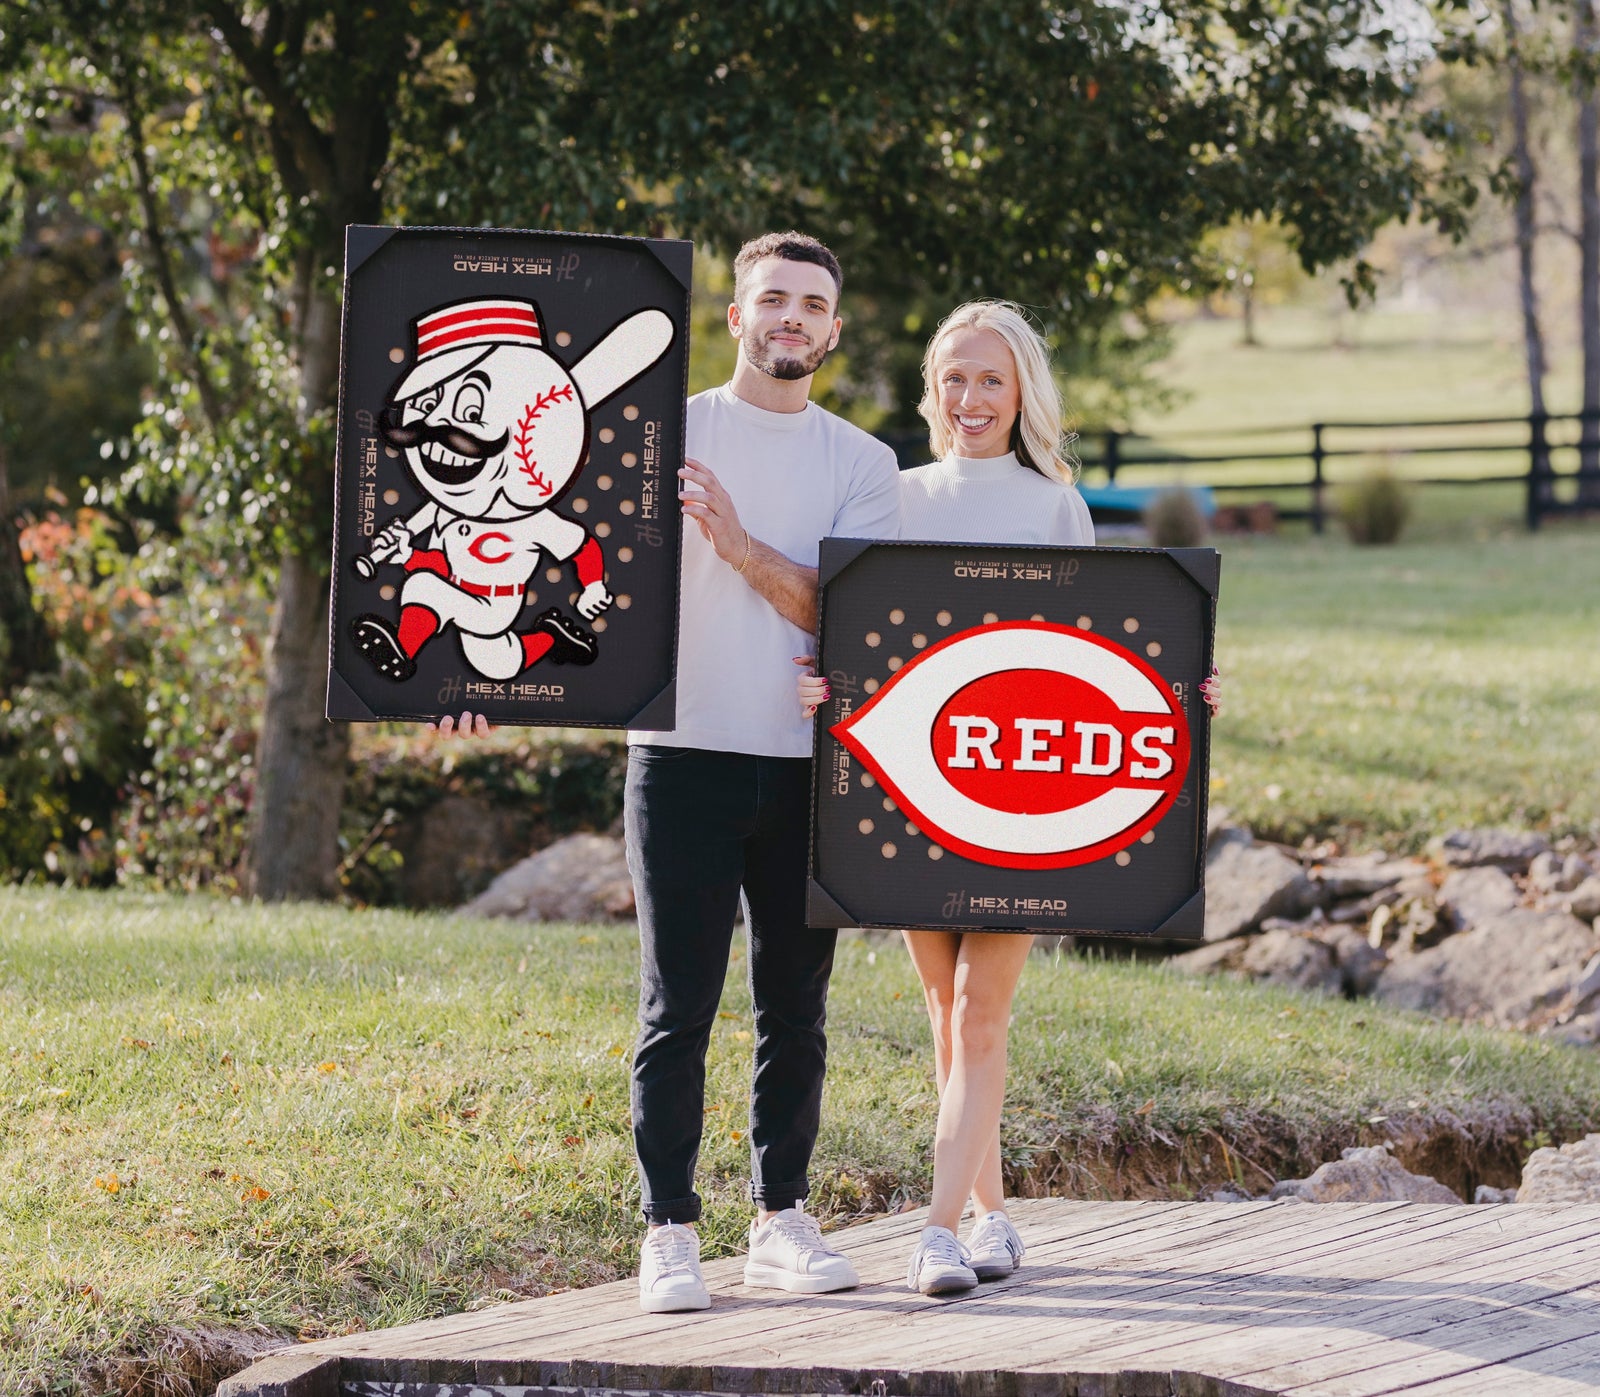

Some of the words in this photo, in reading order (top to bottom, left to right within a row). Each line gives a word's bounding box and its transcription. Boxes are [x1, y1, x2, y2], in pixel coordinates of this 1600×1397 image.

[453, 261, 507, 273] HEAD
[512, 263, 551, 275] HEX
[643, 421, 655, 474] HEAD
[366, 438, 377, 477] HEX
[642, 480, 653, 519] HEX
[363, 483, 376, 536] HEAD
[954, 567, 1007, 579] HEAD
[1012, 569, 1051, 580] HEX
[466, 682, 505, 694] HEX
[511, 684, 564, 695] HEAD
[948, 715, 1174, 779] REDS
[970, 897, 1008, 908] HEX
[1014, 898, 1067, 910] HEAD
